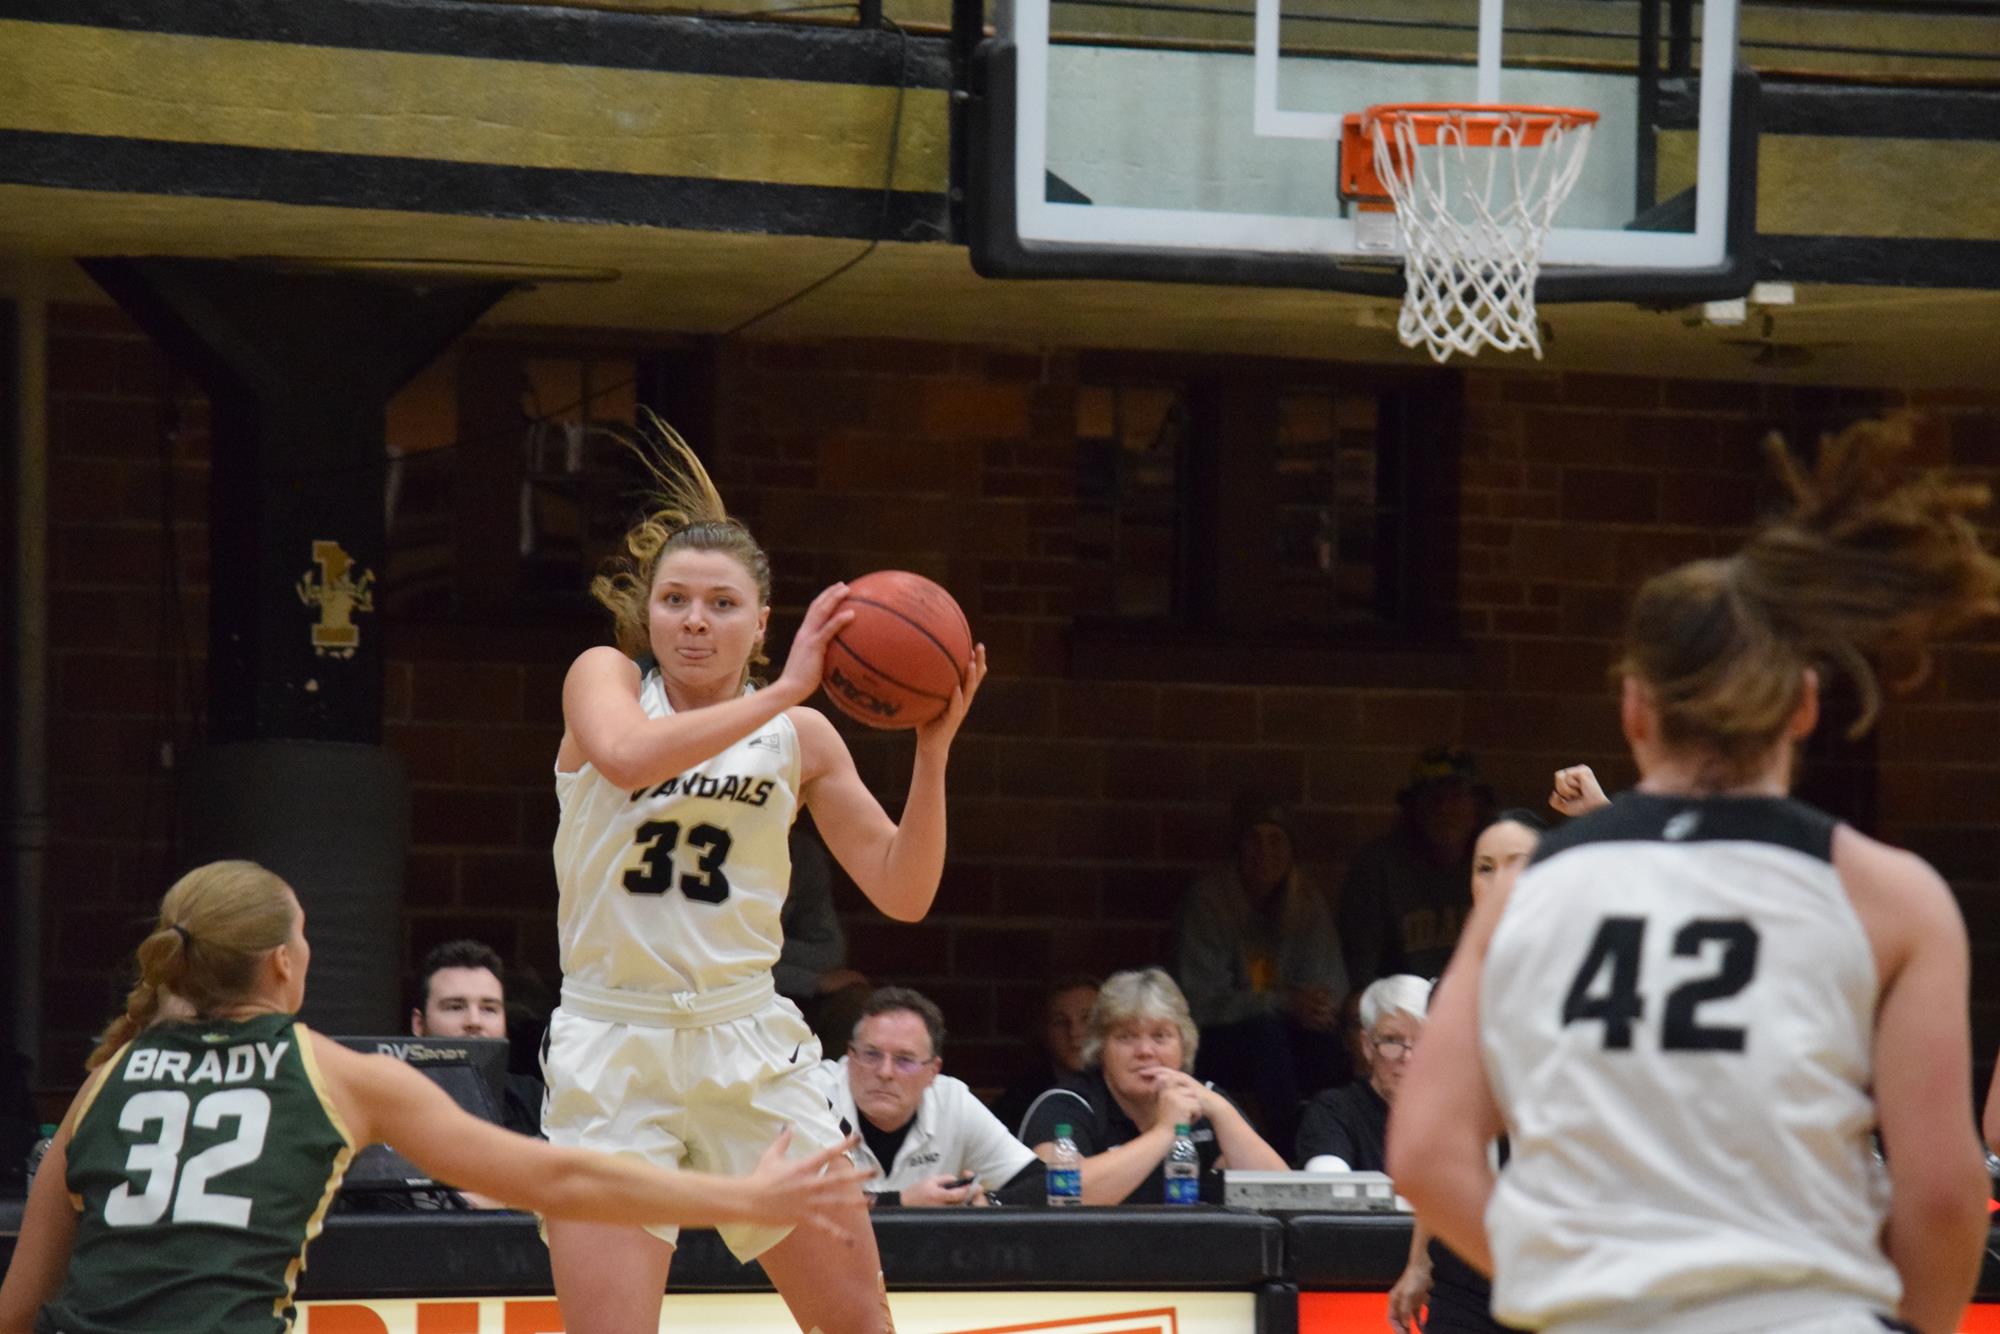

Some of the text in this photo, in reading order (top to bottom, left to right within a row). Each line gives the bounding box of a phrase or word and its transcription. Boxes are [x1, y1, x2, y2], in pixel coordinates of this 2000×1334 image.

[622, 819, 734, 904] 33
[1561, 914, 1761, 1054] 42
[123, 1041, 289, 1084] BRADY
[104, 1088, 271, 1229] 32
